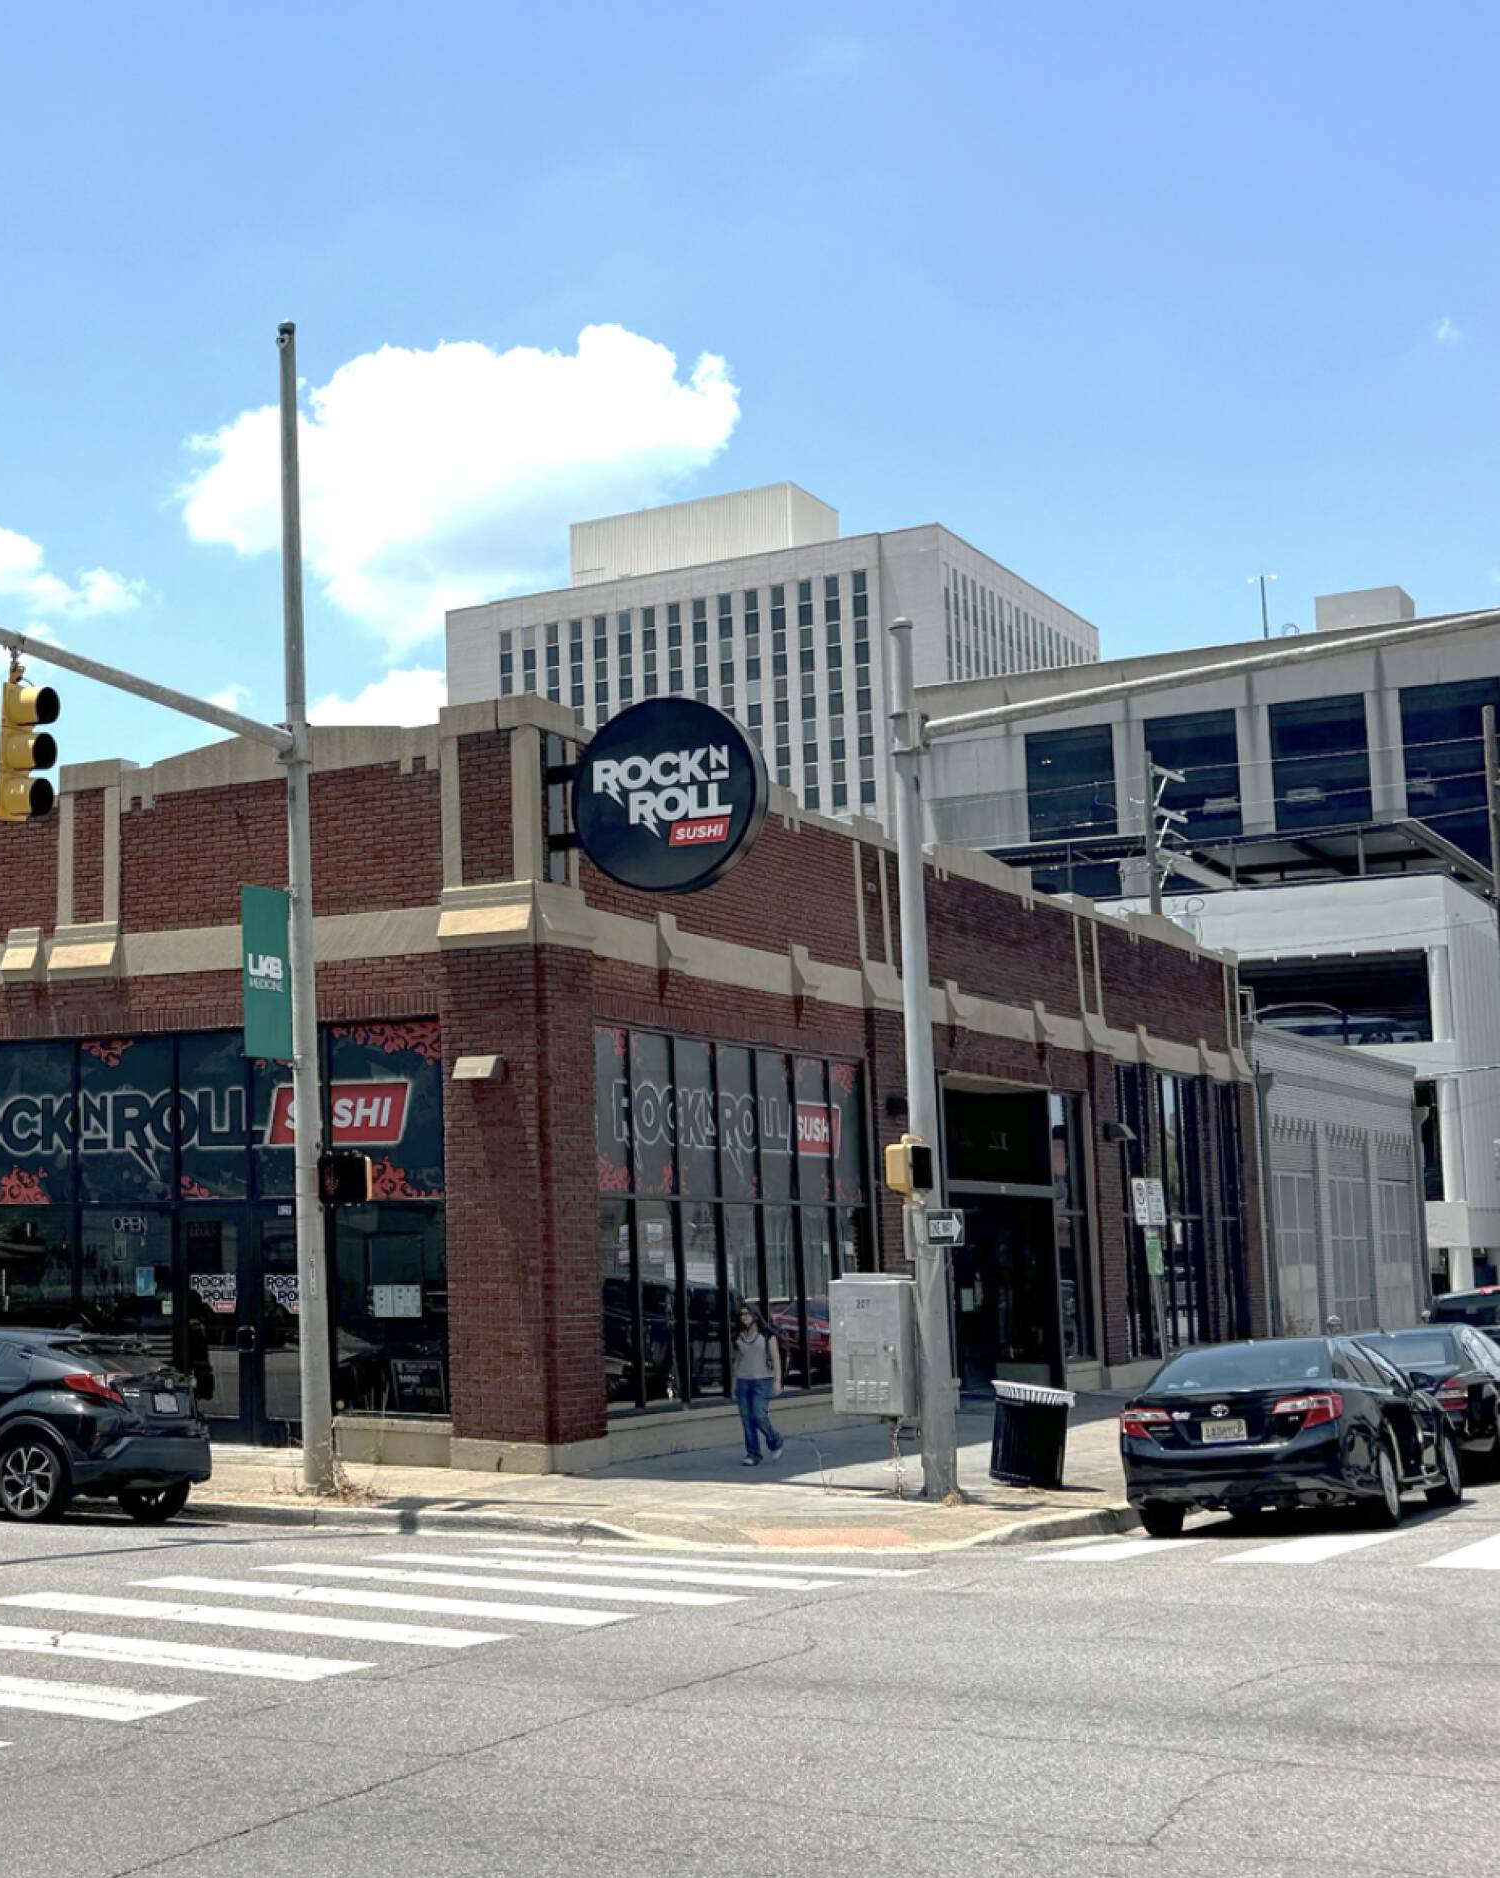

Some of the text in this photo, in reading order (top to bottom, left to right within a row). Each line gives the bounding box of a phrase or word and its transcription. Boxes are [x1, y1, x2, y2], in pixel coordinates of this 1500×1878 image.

[592, 746, 710, 809] ROCK
[628, 782, 733, 839] ROLL
[675, 823, 724, 840] SUSHI
[248, 952, 284, 979] UAB
[284, 1095, 393, 1132] SSHI
[797, 1115, 831, 1143] SUSH
[110, 1087, 270, 1181] ROLL
[111, 1216, 148, 1236] OPEN
